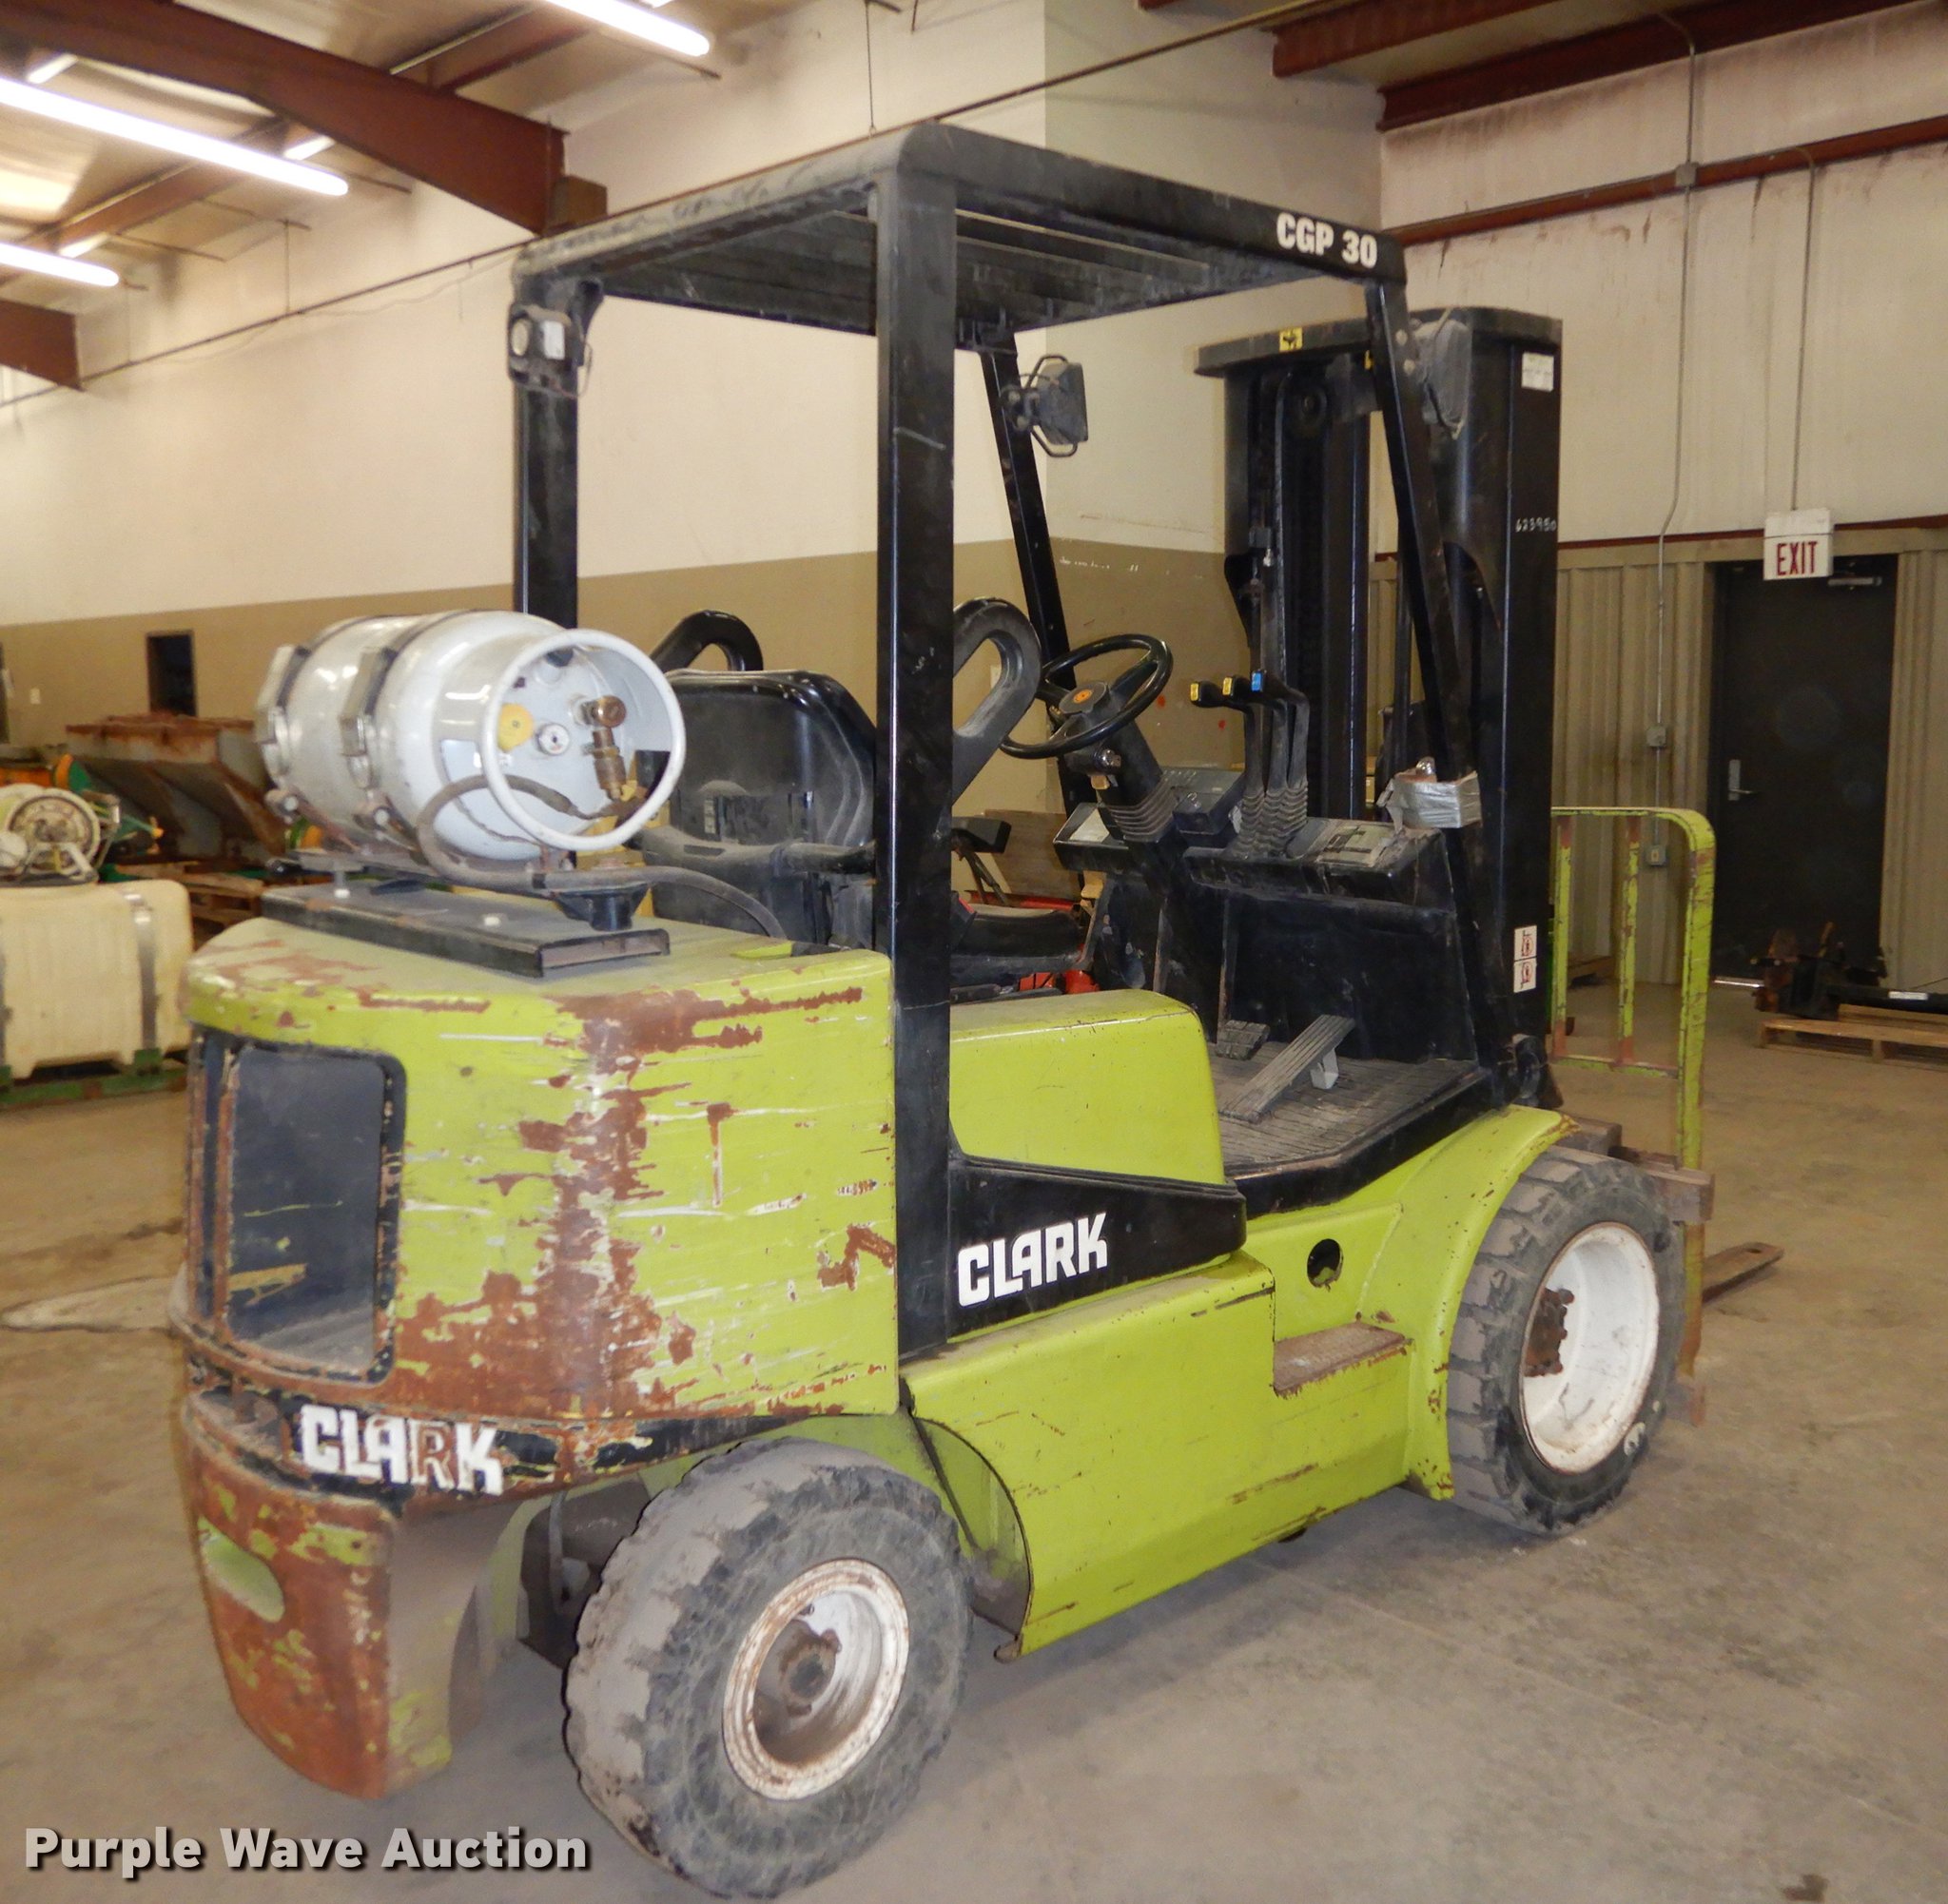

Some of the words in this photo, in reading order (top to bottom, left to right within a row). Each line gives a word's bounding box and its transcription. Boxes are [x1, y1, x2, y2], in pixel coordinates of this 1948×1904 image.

[1276, 212, 1334, 257] CGP
[1341, 229, 1378, 269] 30
[1776, 540, 1818, 576] EXIT
[958, 1212, 1108, 1308] CLARK
[301, 1404, 504, 1496] CLARK
